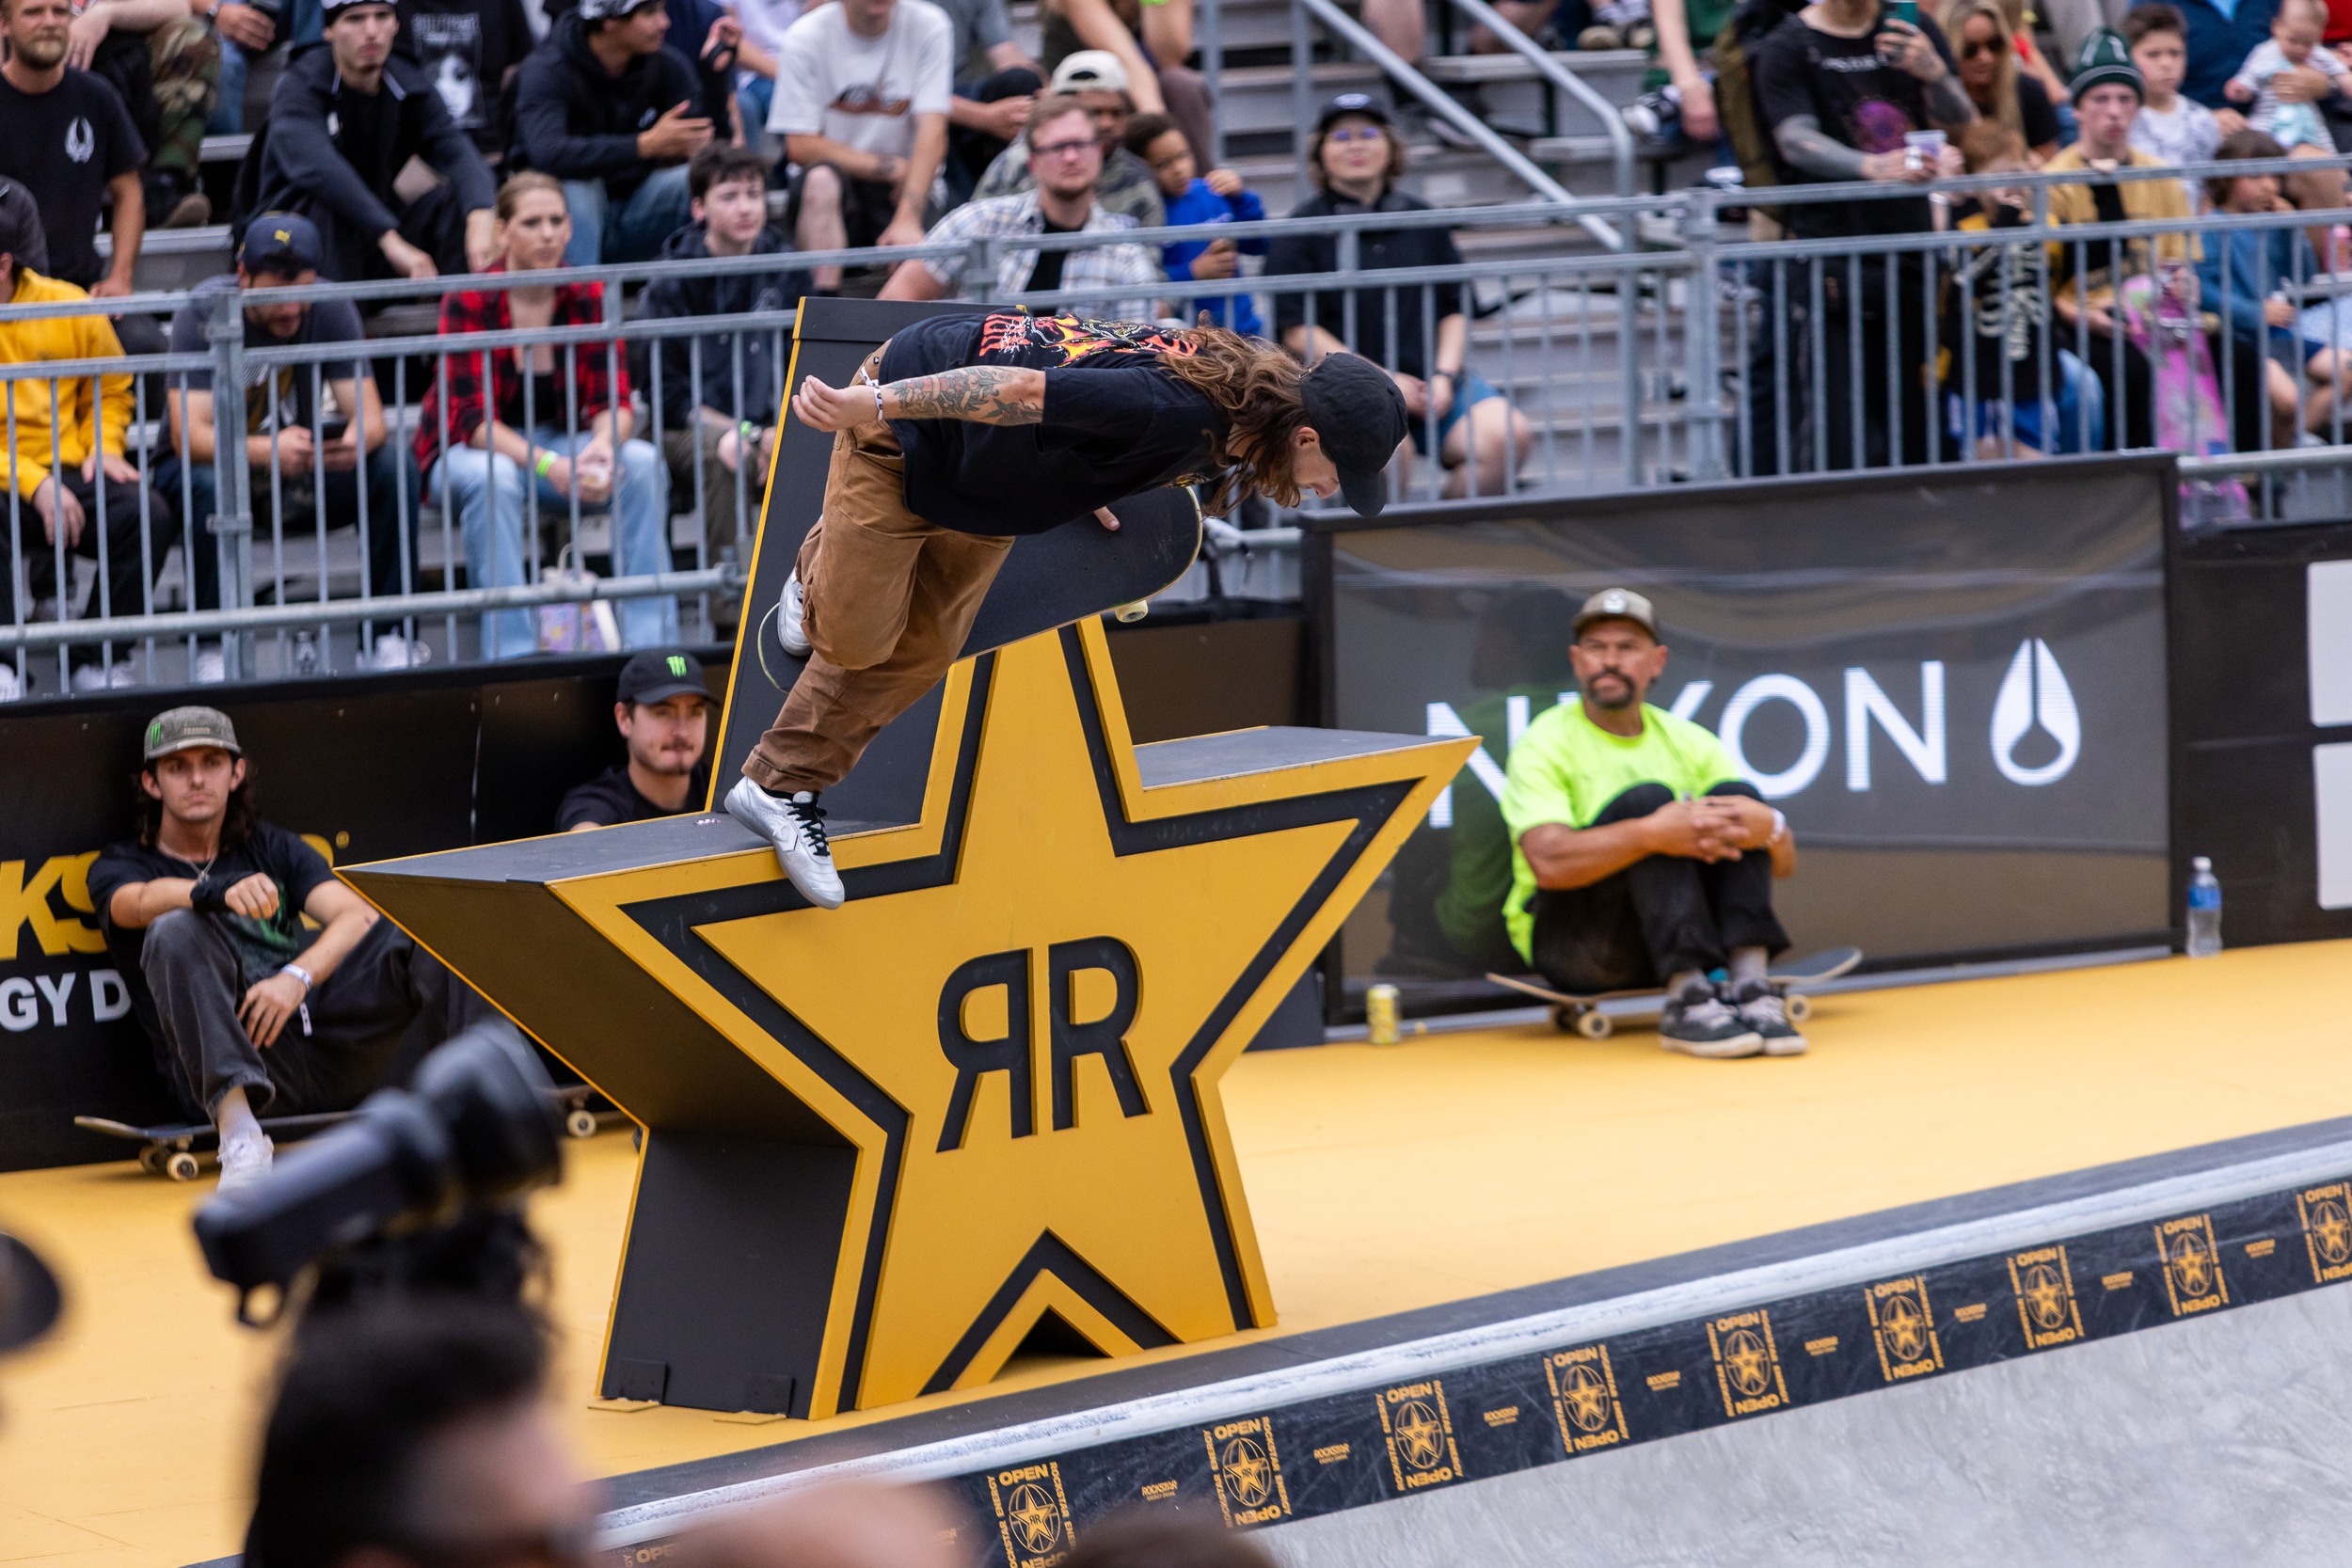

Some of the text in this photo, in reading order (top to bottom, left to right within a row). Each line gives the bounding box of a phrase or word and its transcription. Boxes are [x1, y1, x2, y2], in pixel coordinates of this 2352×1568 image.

[1427, 661, 1947, 829] NON
[1716, 1311, 1760, 1332] OPEN
[1553, 1346, 1598, 1367] OPEN
[1387, 1382, 1433, 1403] OPEN
[1215, 1418, 1261, 1440] OPEN
[1574, 1430, 1619, 1449] OPEN
[1262, 1417, 1280, 1472] ROCKSTAR
[999, 1464, 1049, 1486] OPEN
[1406, 1467, 1453, 1488] OPEN
[987, 1476, 1005, 1517] ENERGY
[1049, 1462, 1071, 1518] ROCKSTAR
[1234, 1505, 1281, 1526] OPEN
